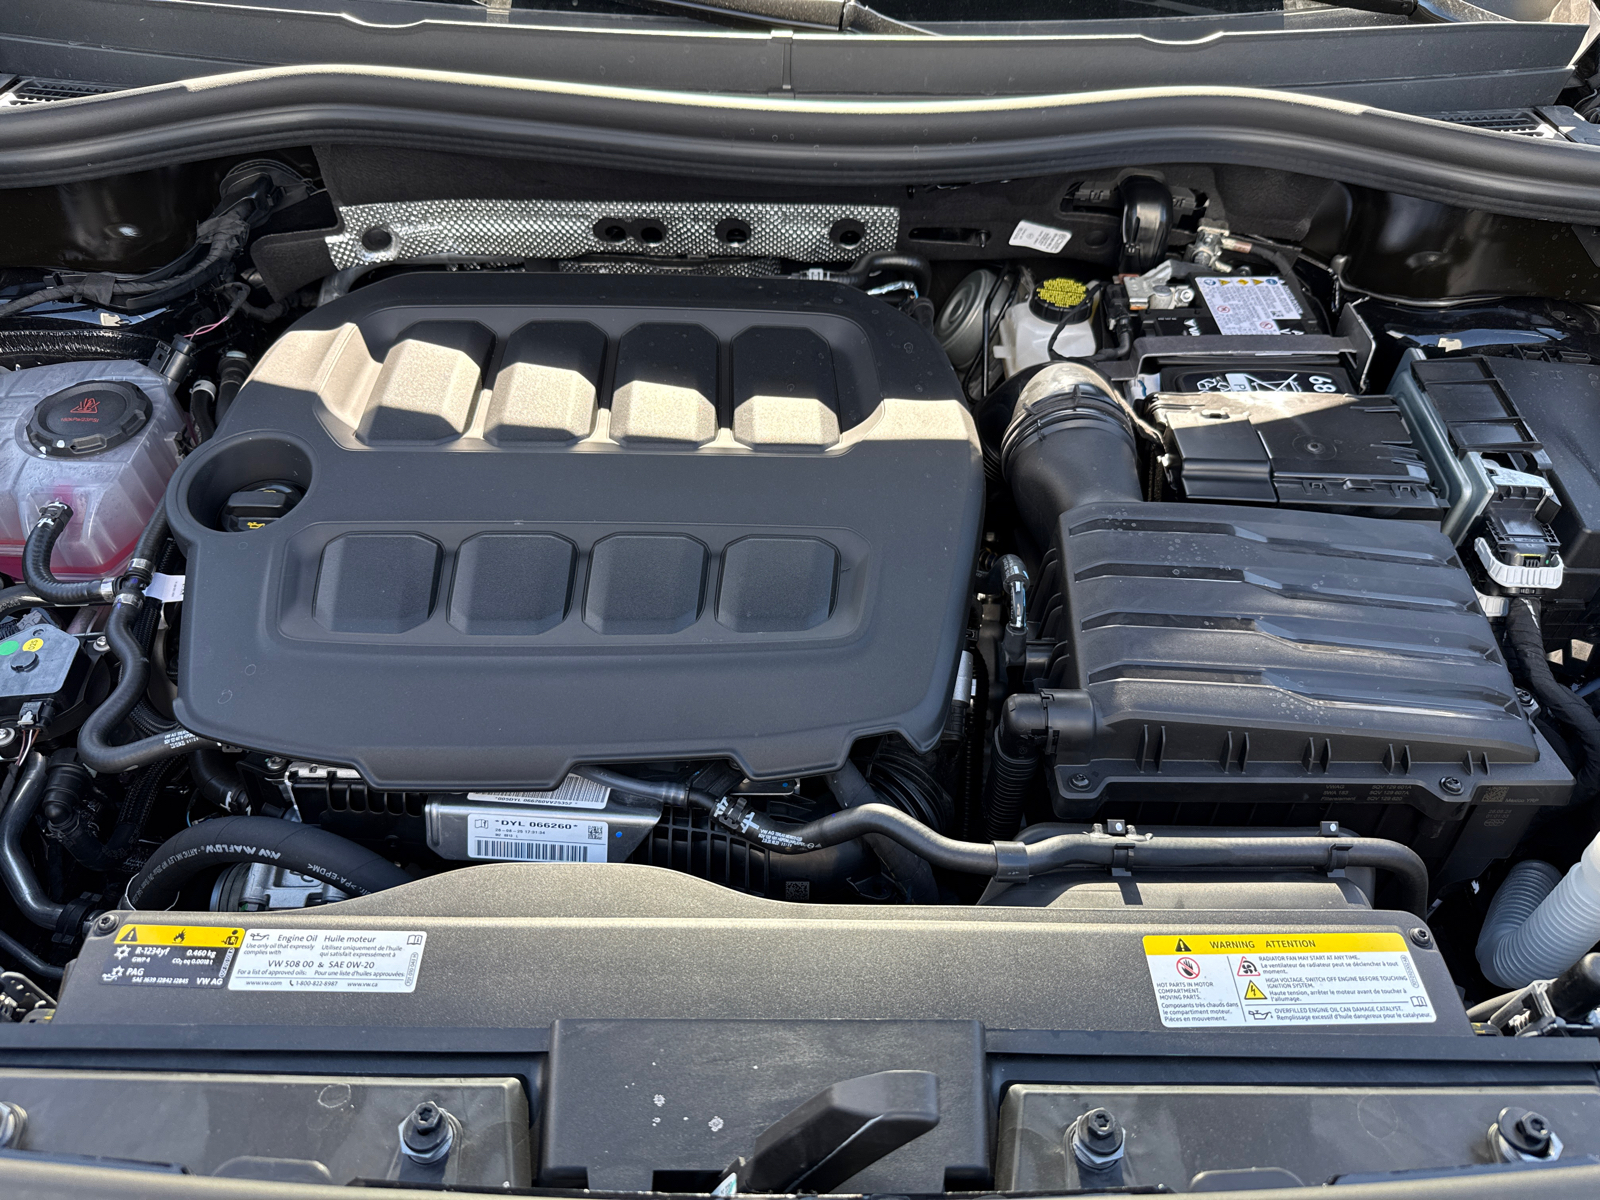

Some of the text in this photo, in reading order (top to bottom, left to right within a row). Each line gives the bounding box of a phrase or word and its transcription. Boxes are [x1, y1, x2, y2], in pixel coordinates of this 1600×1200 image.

[205, 844, 257, 855] MAFLOW
[278, 935, 304, 943] Engine
[1209, 940, 1316, 949] WARNING ATTENTION
[135, 947, 170, 957] R-1234yf
[208, 950, 216, 958] kg
[268, 960, 283, 968] VW
[284, 960, 300, 968] 508
[328, 961, 344, 969] SAE
[346, 961, 375, 969] 0W-20
[126, 968, 145, 976] PAG
[211, 978, 224, 986] AG
[1161, 1002, 1194, 1010] Composants
